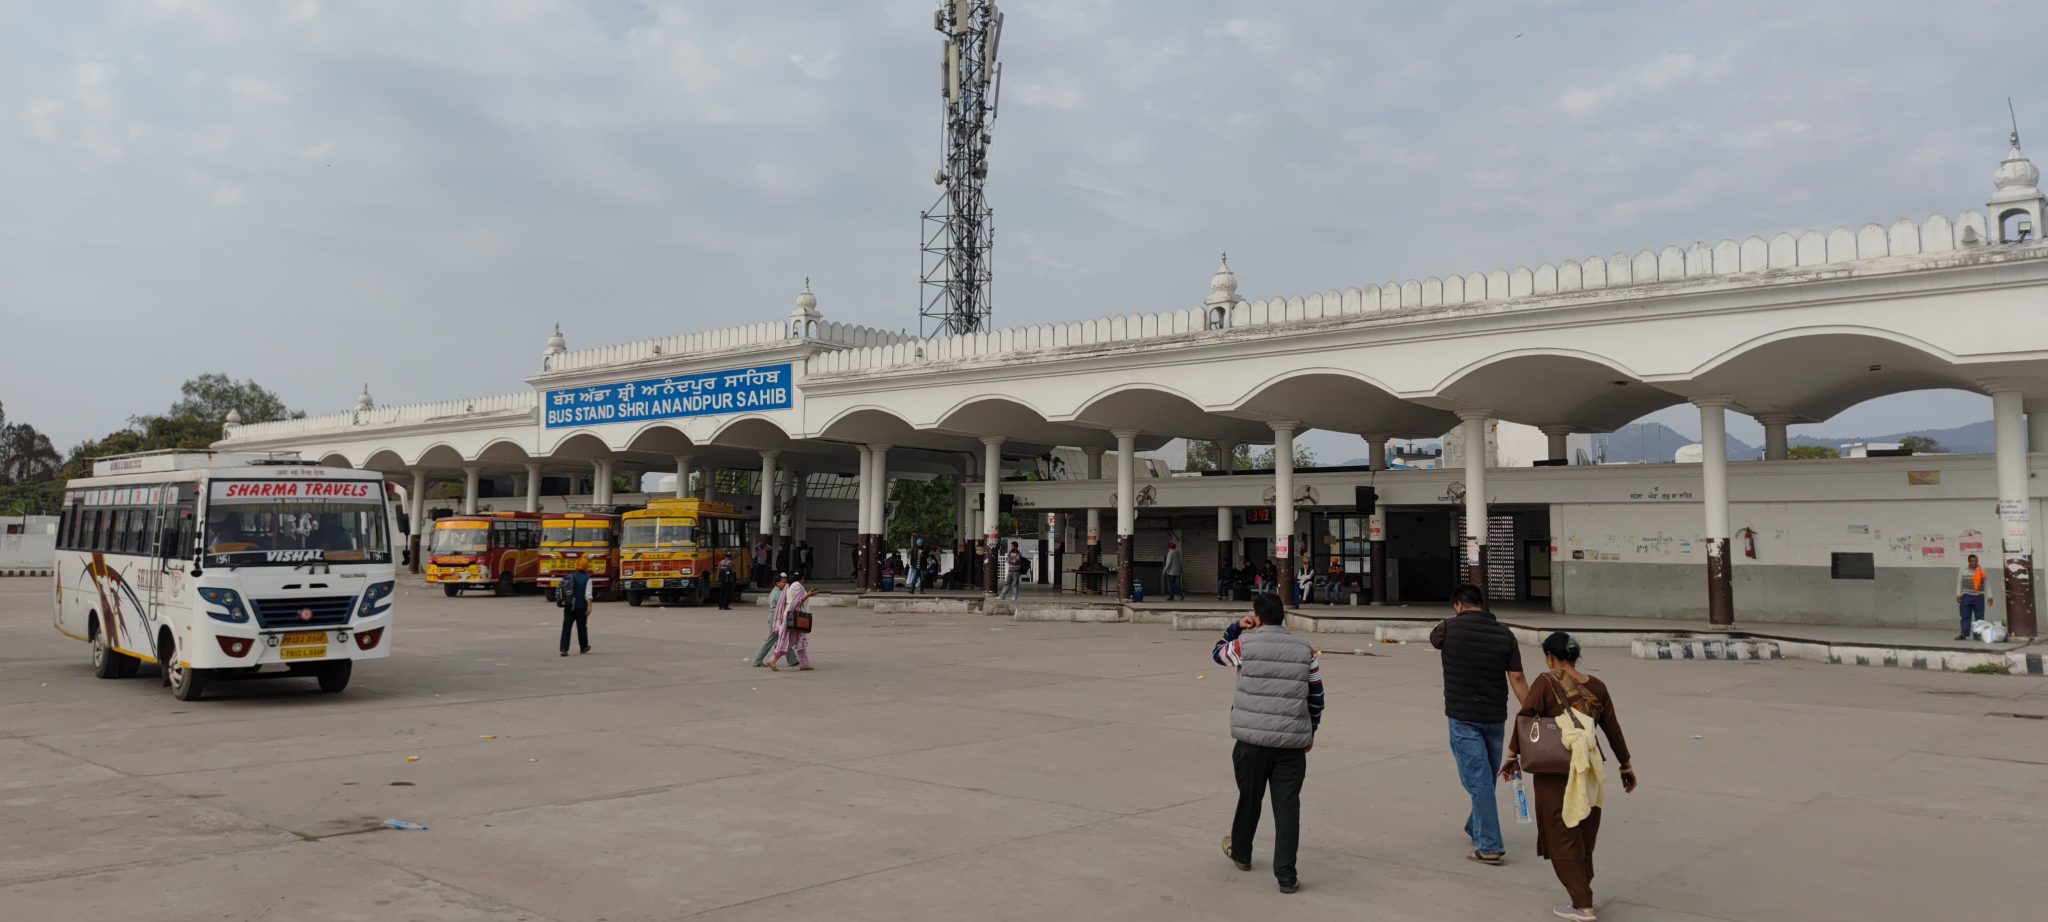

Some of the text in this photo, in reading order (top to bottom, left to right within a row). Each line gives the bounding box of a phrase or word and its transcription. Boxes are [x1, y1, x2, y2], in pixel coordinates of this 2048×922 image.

[553, 390, 576, 405] ਬੱਸ
[579, 387, 612, 402] ਅੱਡਾ
[723, 369, 781, 387] ਸਾਹਿਬ
[548, 387, 787, 424] BUS STAND SHRI ANANDPUR SAHIB
[226, 483, 369, 498] SHARMA TRAVELS
[266, 550, 325, 562] VISHAL
